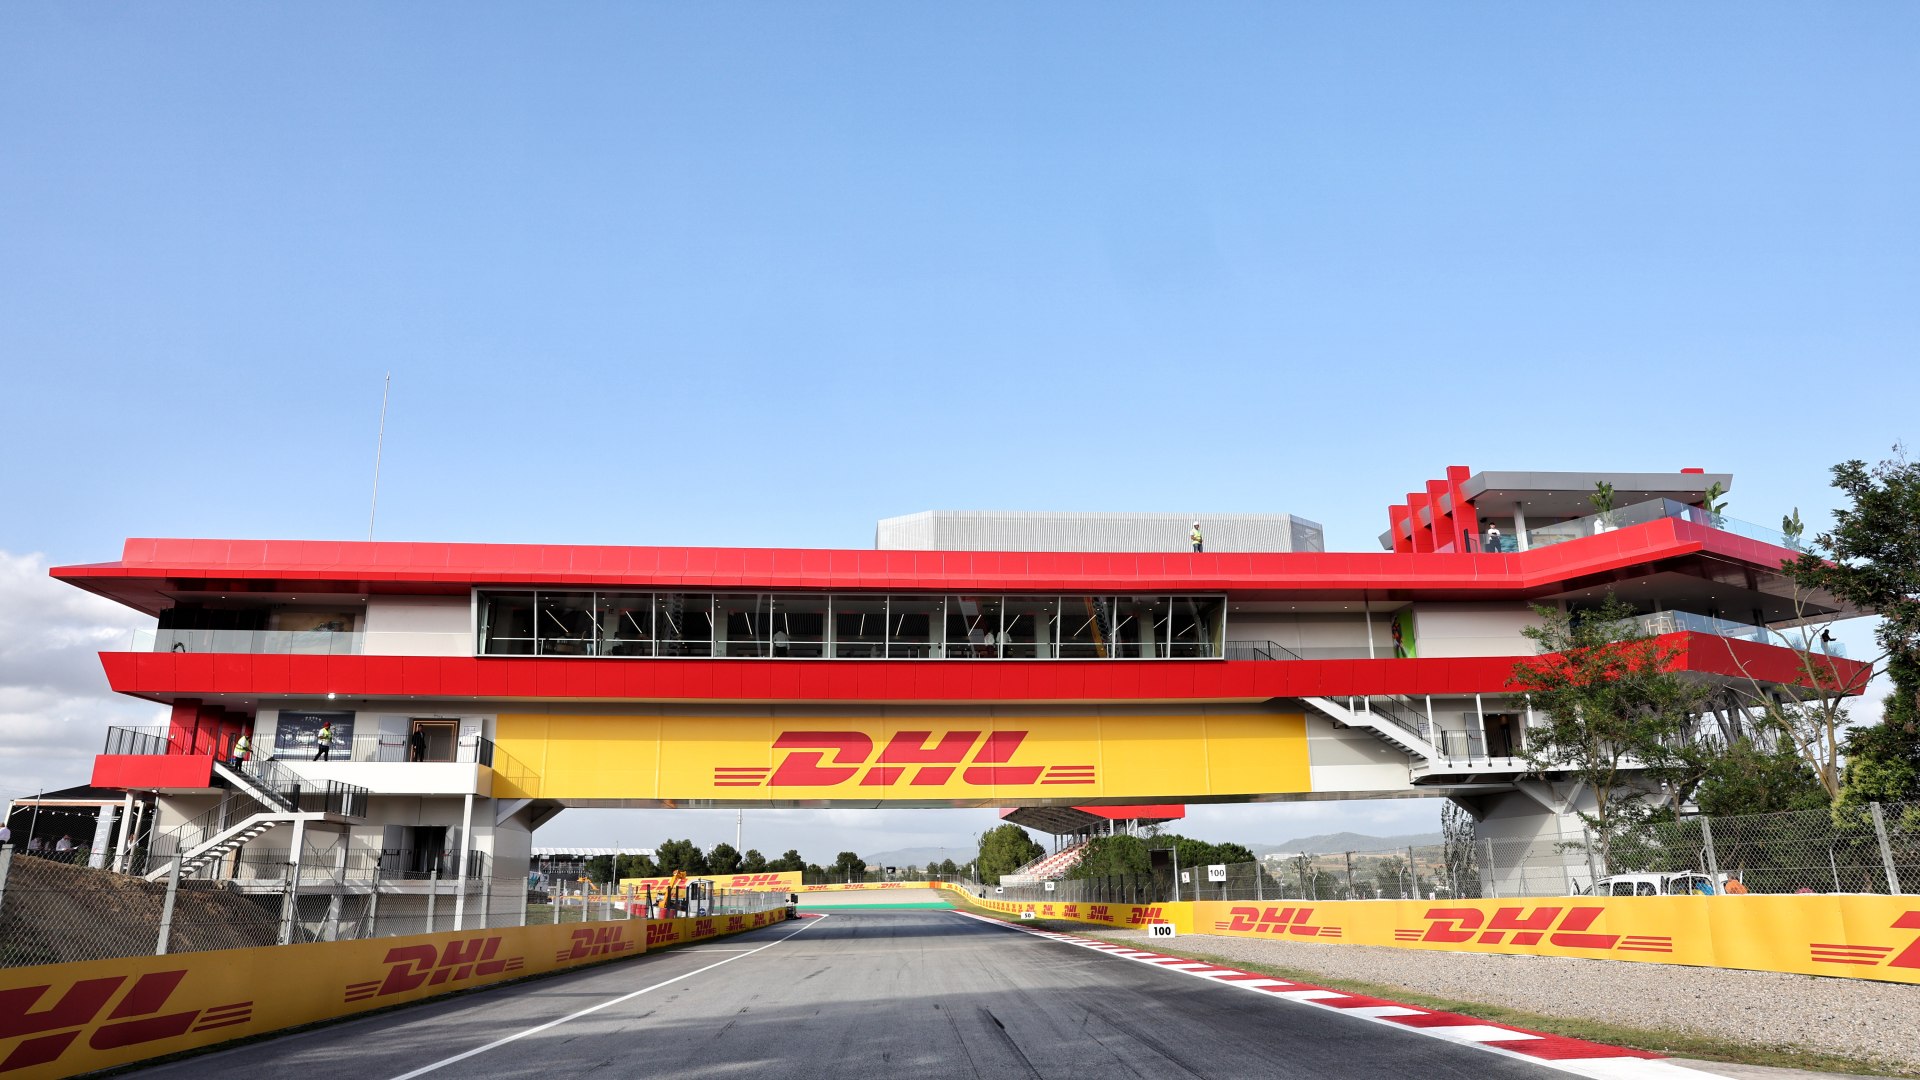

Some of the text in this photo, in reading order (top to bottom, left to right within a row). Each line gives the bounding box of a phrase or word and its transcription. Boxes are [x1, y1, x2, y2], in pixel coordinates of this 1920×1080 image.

[766, 731, 1046, 786] DHL
[731, 874, 782, 887] DHL
[1210, 869, 1225, 877] 100
[1090, 905, 1109, 921] DHL
[1131, 907, 1165, 924] DHL
[1229, 907, 1320, 936] DHL
[647, 922, 675, 945] DHL
[695, 919, 714, 936] DHL
[1153, 926, 1171, 936] 100
[1423, 908, 1621, 950] DHL
[568, 926, 626, 960] DHL
[377, 936, 507, 996] DHL
